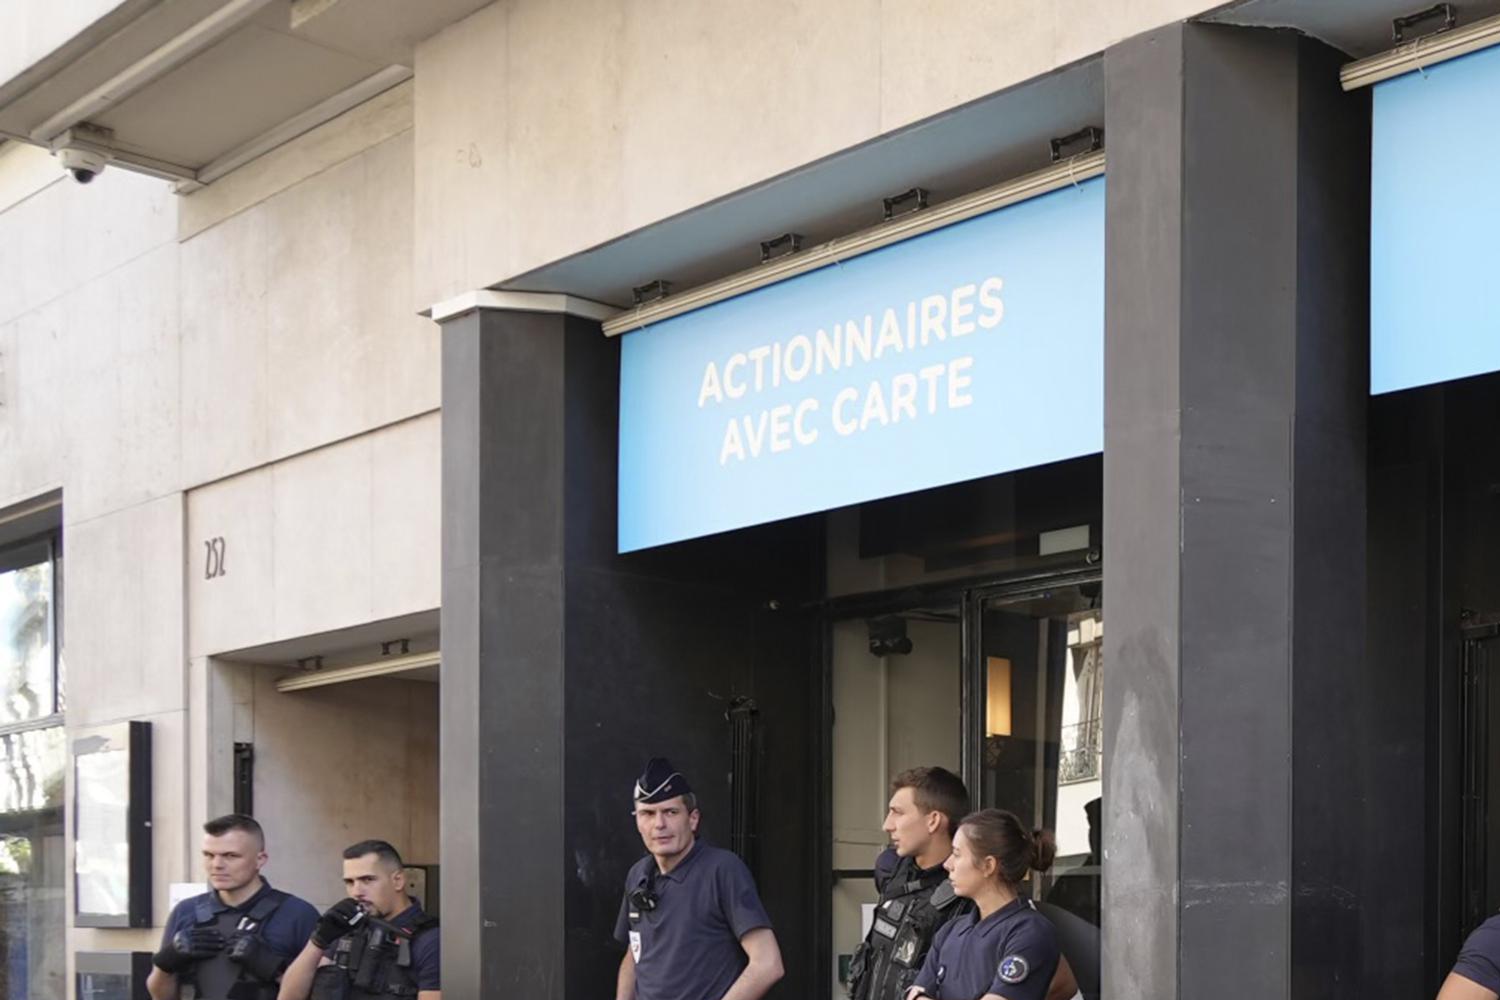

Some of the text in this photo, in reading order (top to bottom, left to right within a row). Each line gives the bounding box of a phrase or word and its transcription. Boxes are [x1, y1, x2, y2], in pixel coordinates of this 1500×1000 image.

[698, 277, 1004, 408] ACTIONNAIRES
[720, 357, 974, 466] AVEC CARTE
[204, 536, 226, 580] 252
